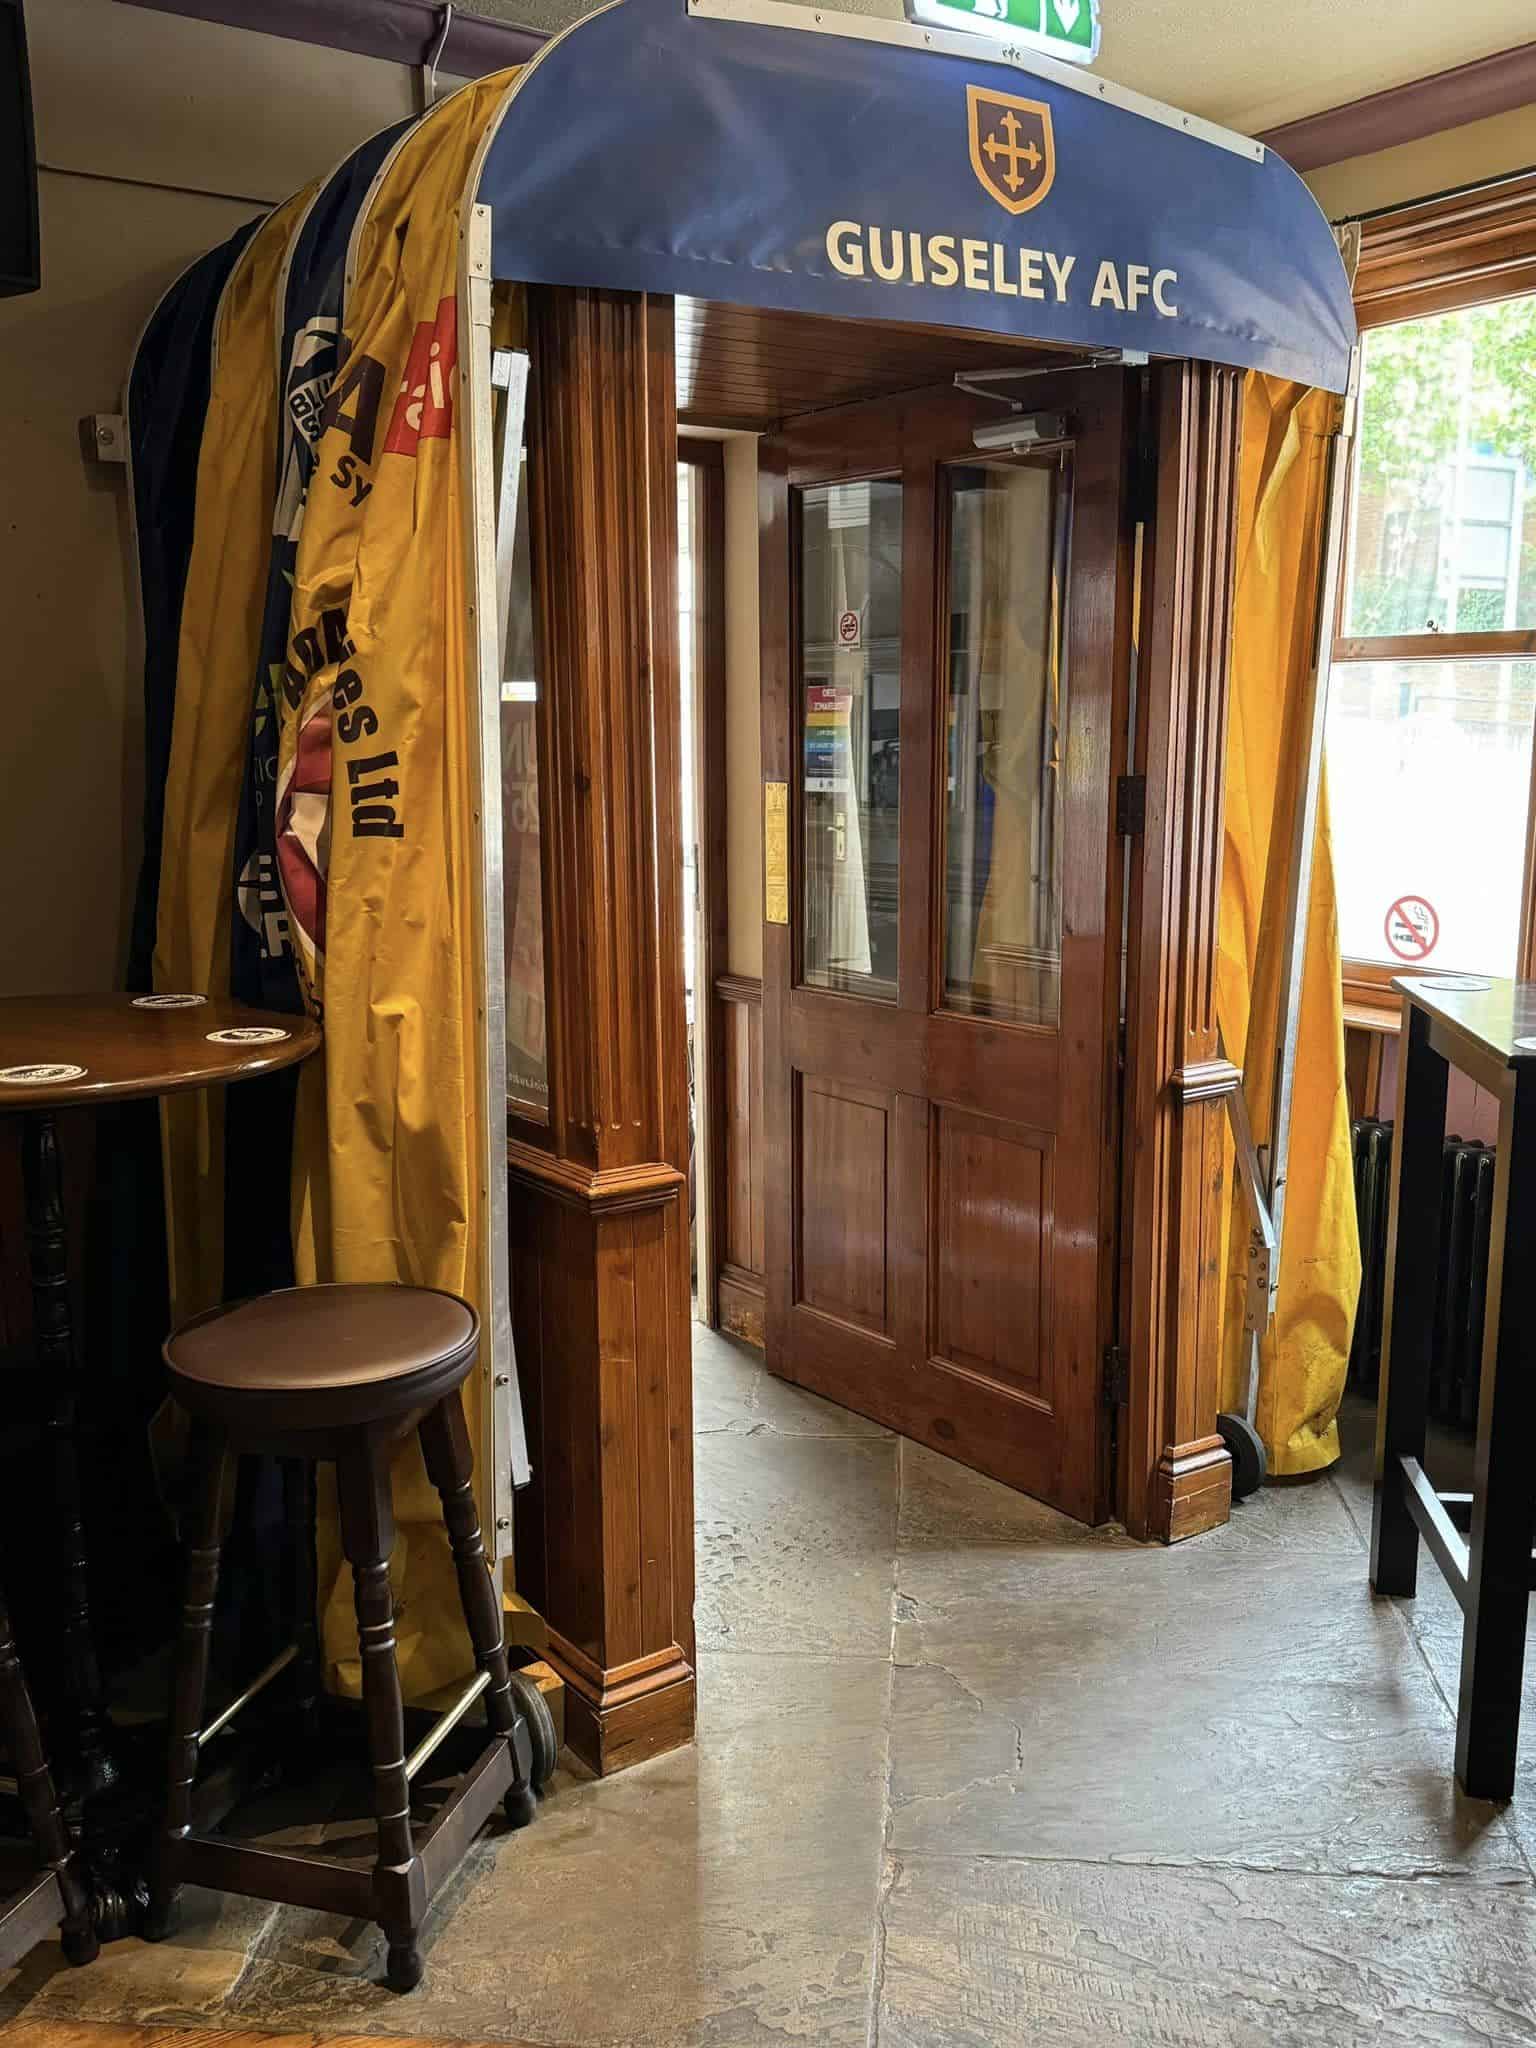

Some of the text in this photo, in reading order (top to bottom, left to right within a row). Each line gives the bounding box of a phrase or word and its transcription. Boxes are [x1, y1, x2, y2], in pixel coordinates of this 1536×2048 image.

[825, 220, 1179, 317] GUISELEY AFC
[346, 750, 405, 839] Ltd
